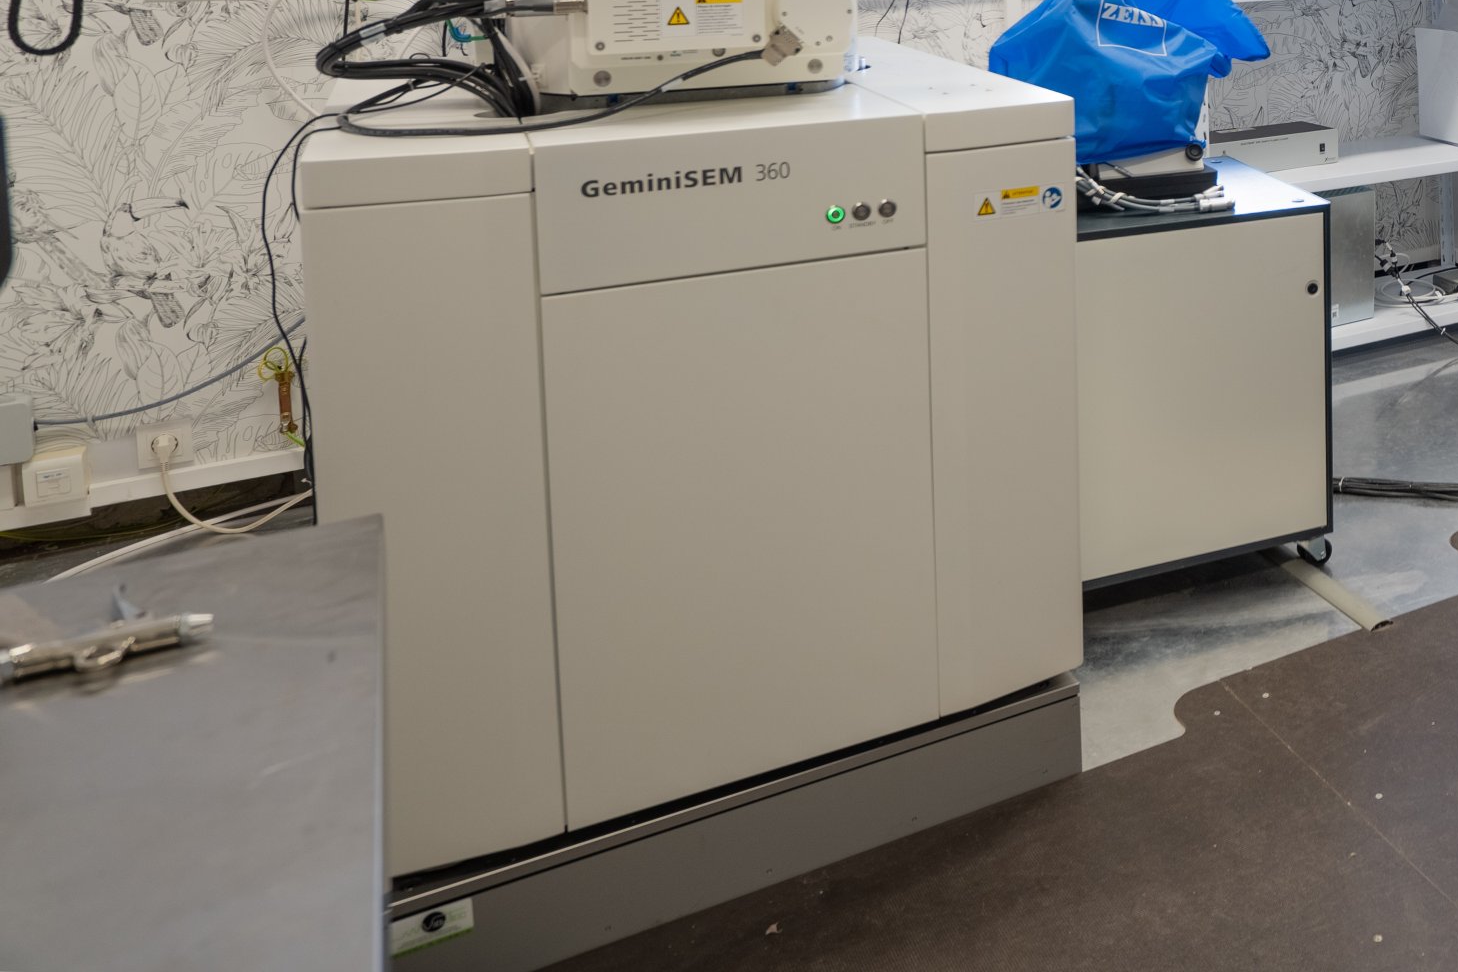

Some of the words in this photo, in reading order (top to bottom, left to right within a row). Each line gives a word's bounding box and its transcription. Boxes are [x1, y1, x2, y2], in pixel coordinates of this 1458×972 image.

[1101, 2, 1164, 28] ZEISS
[581, 166, 743, 198] GeminiSEM
[755, 161, 791, 182] 360
